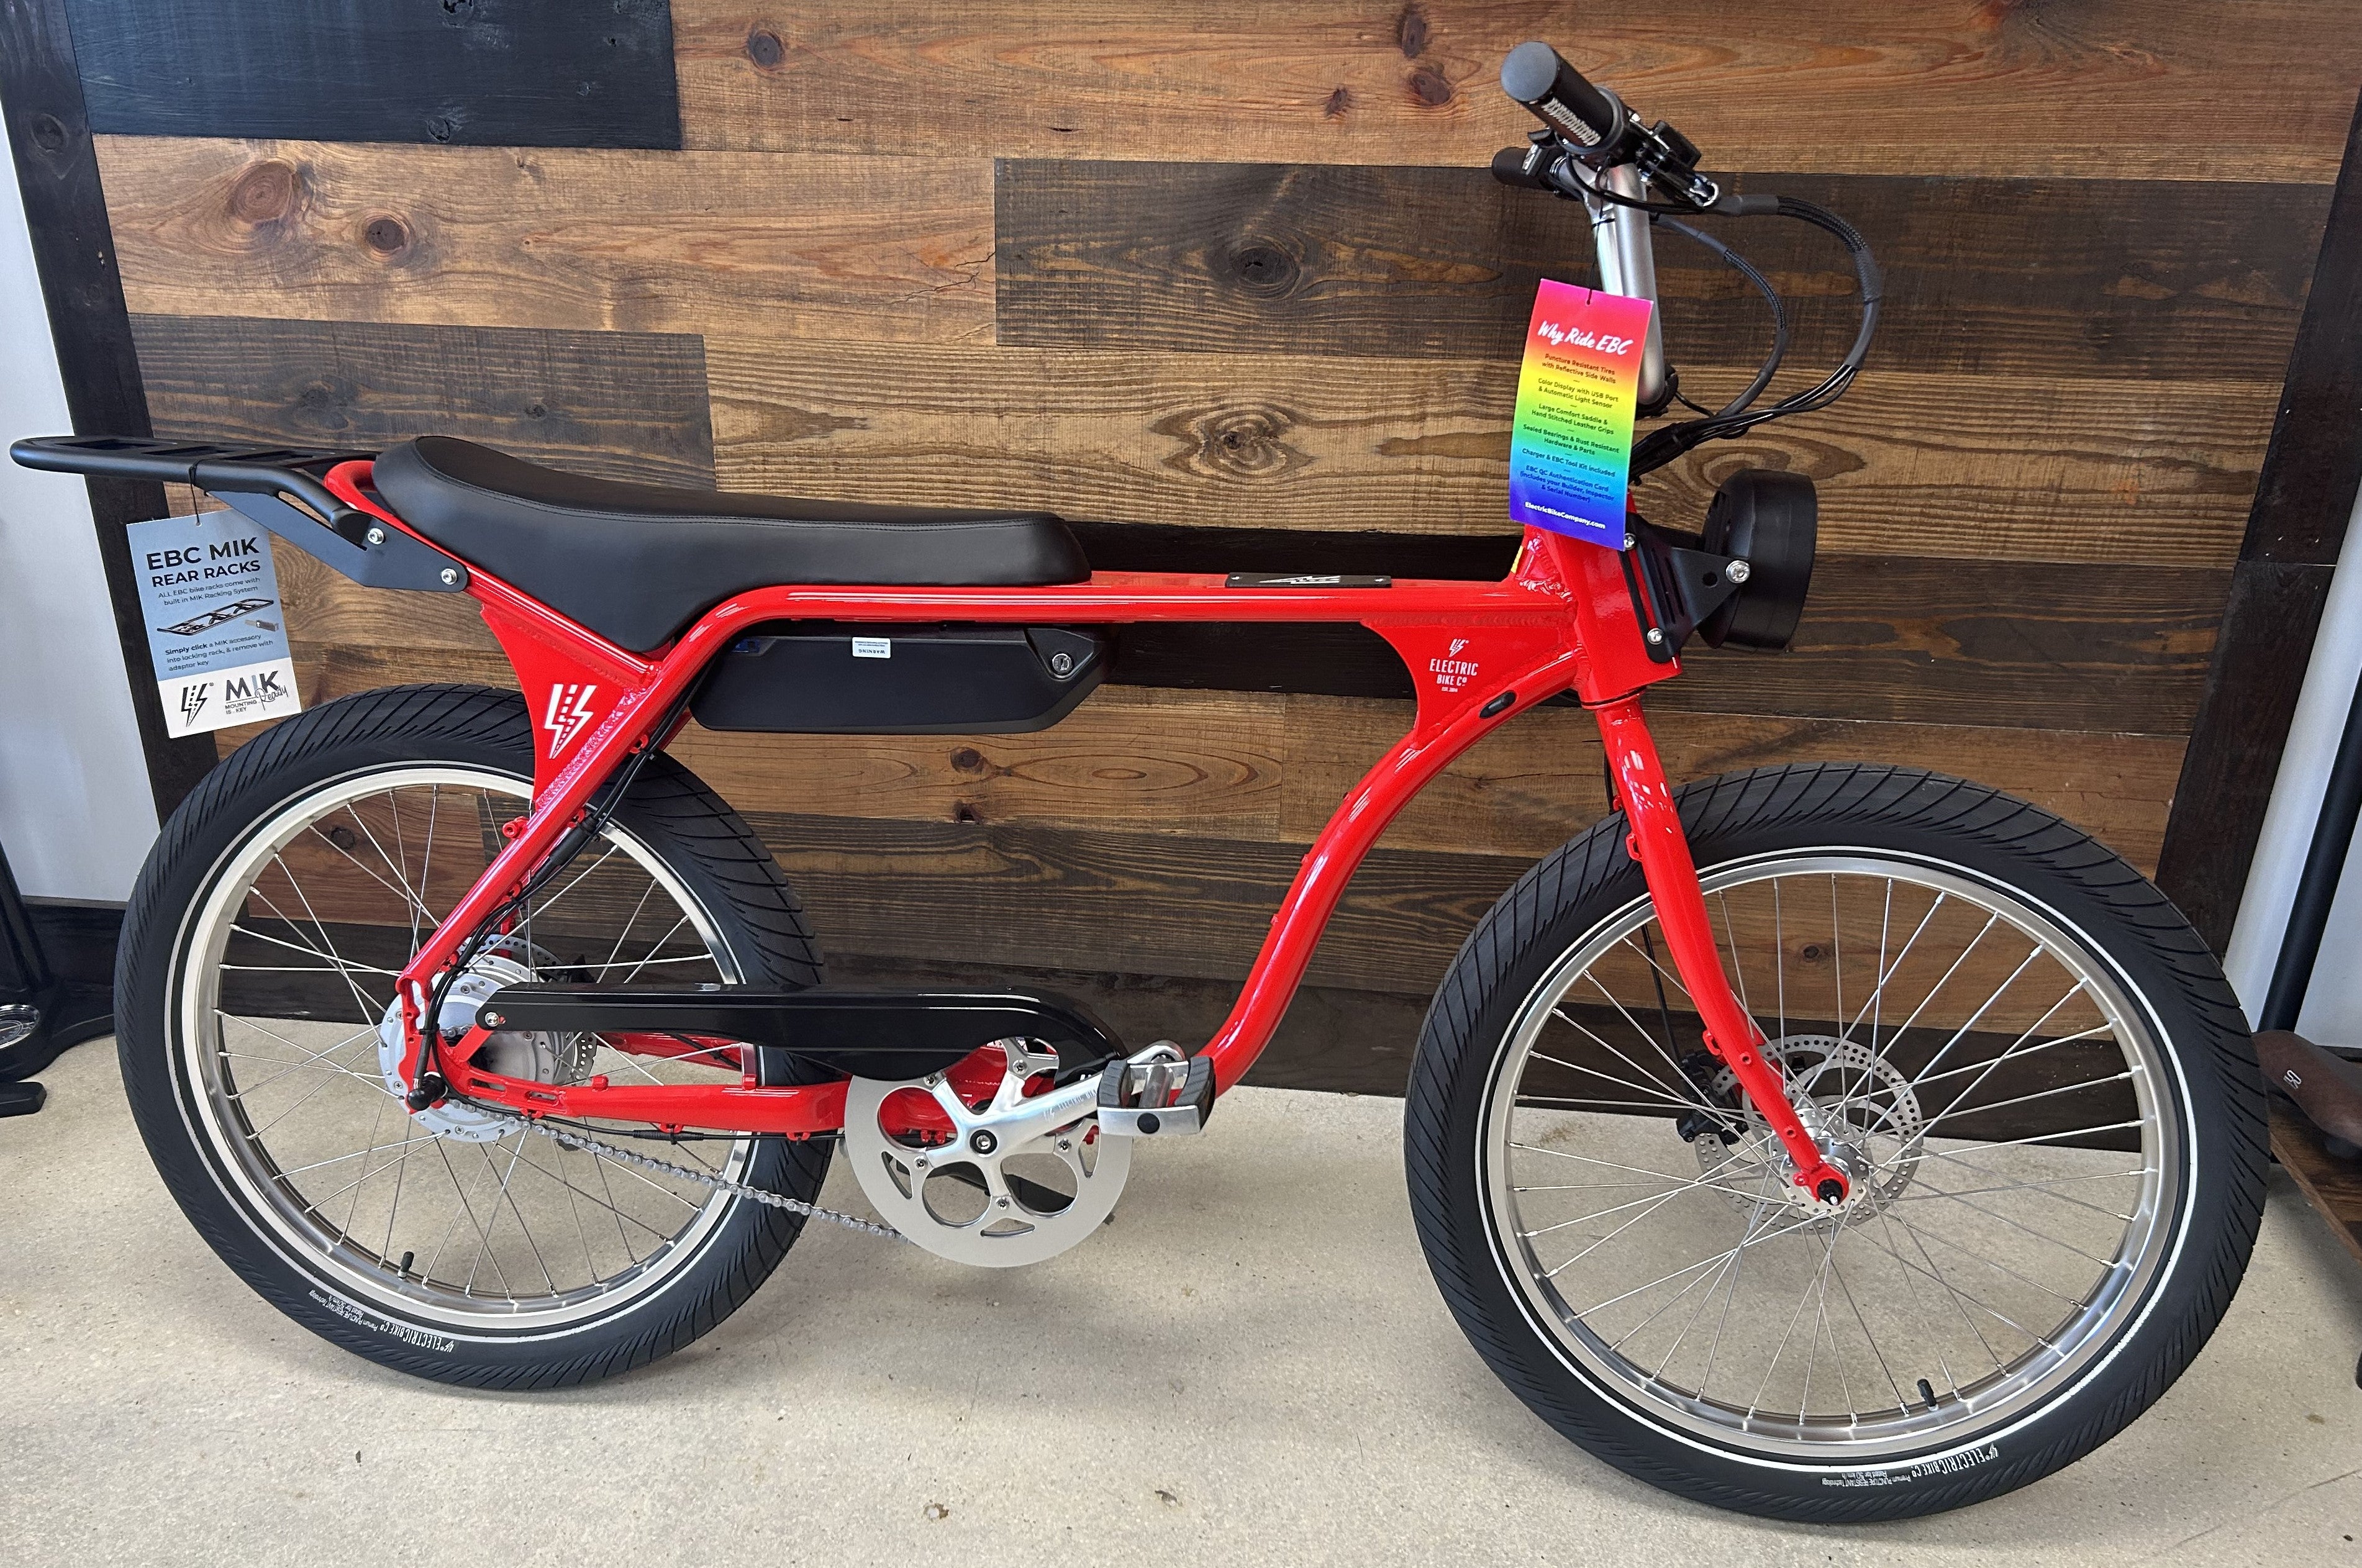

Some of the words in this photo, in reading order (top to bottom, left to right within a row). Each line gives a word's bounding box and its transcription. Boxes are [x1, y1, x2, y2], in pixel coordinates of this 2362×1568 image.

[1537, 320, 1565, 345] Why
[1564, 327, 1596, 348] Ride
[1596, 335, 1633, 355] EBC
[1545, 353, 1570, 365] Puncture
[1573, 360, 1599, 371] Resistant
[1555, 365, 1584, 376] Reflective
[1586, 372, 1598, 380] Side
[1600, 376, 1616, 384] Walls
[1554, 382, 1575, 392] Display
[1544, 387, 1573, 399] Automatic
[1574, 395, 1590, 404] Light
[1592, 399, 1613, 409] Sensor
[1532, 410, 1547, 418] Hand
[1548, 413, 1572, 424] Stitched
[1573, 420, 1596, 430] Leather
[1598, 426, 1614, 435] Grips
[1539, 404, 1555, 412] Large
[1556, 408, 1580, 418] Comfort
[1581, 414, 1602, 424] Saddle
[1523, 424, 1542, 433] Sealed
[1543, 429, 1569, 441] Bearings
[1576, 438, 1589, 446] Rust
[1591, 441, 1619, 453] Resistant
[1544, 438, 1572, 450] Hardware
[1579, 446, 1595, 455] Parts
[1522, 448, 1545, 458] Charger
[1552, 456, 1564, 464] EBC
[1526, 465, 1538, 473] EBC
[1549, 471, 1593, 488] Authentication
[1594, 483, 1609, 492] Card
[1547, 485, 1563, 494] Serial
[1525, 501, 1606, 529] ElectricBikeCompany.com
[147, 546, 202, 571] EBC
[209, 537, 260, 560] MIK
[152, 570, 199, 587] REAR
[204, 560, 261, 579] RACKS
[204, 589, 232, 599] Racking
[234, 586, 258, 594] System
[165, 646, 189, 655] Simply
[191, 643, 207, 651] click
[229, 635, 261, 644] accessory
[182, 653, 207, 661] locking
[232, 643, 257, 652] remove
[1429, 658, 1479, 676] ELECTRIC
[225, 670, 279, 701] MIK
[1437, 674, 1455, 686] BIKE
[225, 699, 257, 709] MOUNTING
[255, 684, 289, 711] Ready
[389, 1324, 404, 1338] BIKE
[403, 1329, 442, 1350] ELECTRIC
[1924, 1461, 1940, 1475] BIKE
[1941, 1448, 1987, 1474] ELECTRIC
